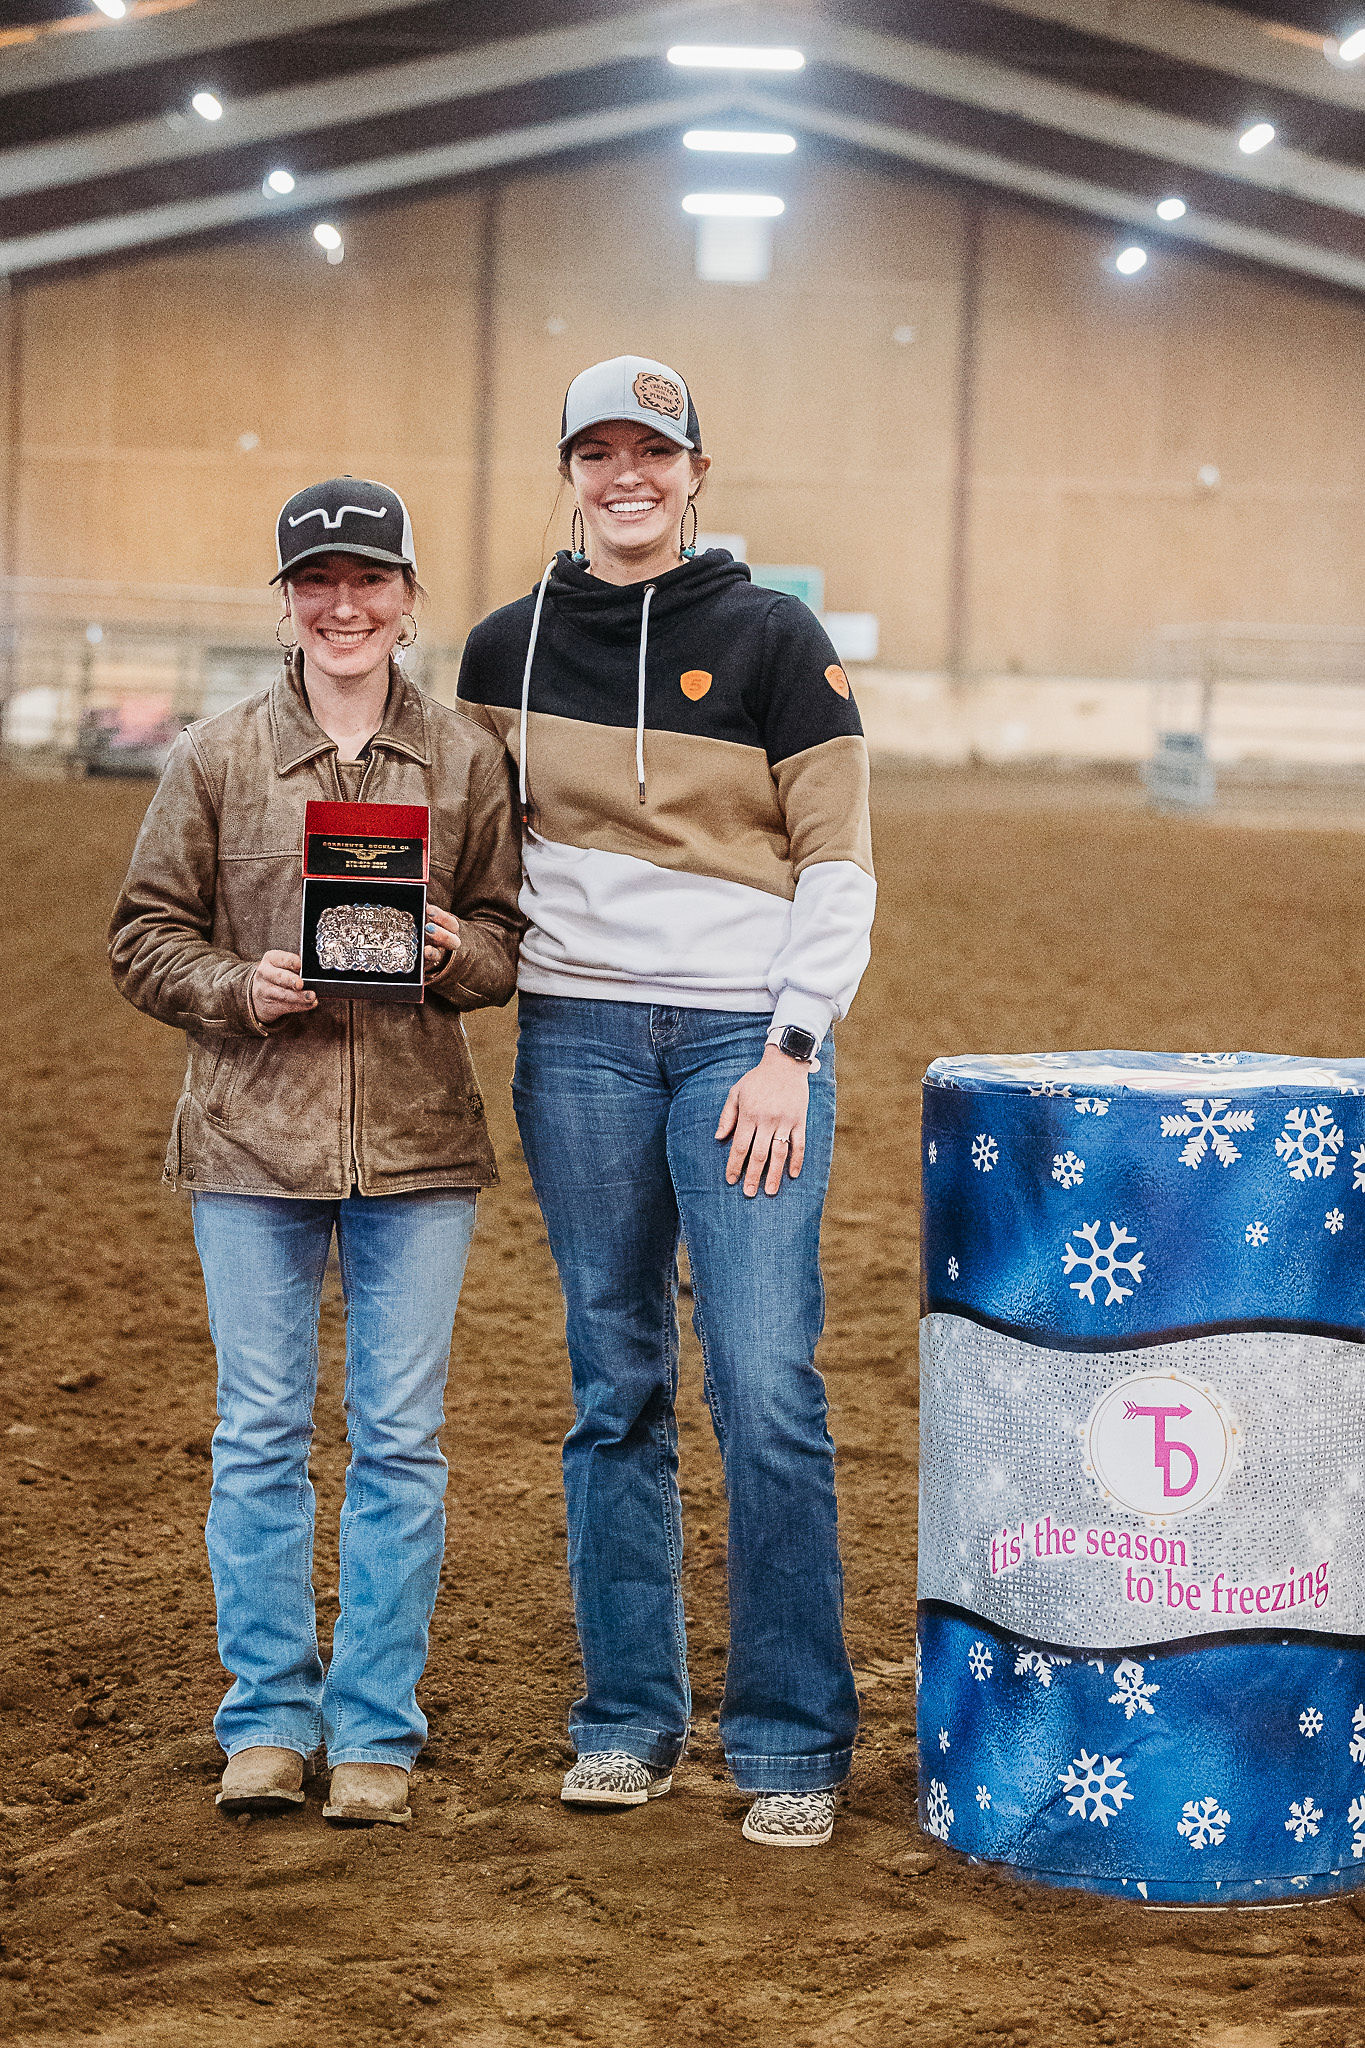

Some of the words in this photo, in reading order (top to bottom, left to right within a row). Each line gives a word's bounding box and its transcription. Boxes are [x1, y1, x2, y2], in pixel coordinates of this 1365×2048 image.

[990, 1523, 1025, 1574] tis'
[1034, 1516, 1076, 1558] the
[1086, 1528, 1188, 1567] season
[1125, 1567, 1154, 1604] to
[1166, 1569, 1201, 1611] be
[1211, 1560, 1330, 1614] freezing
